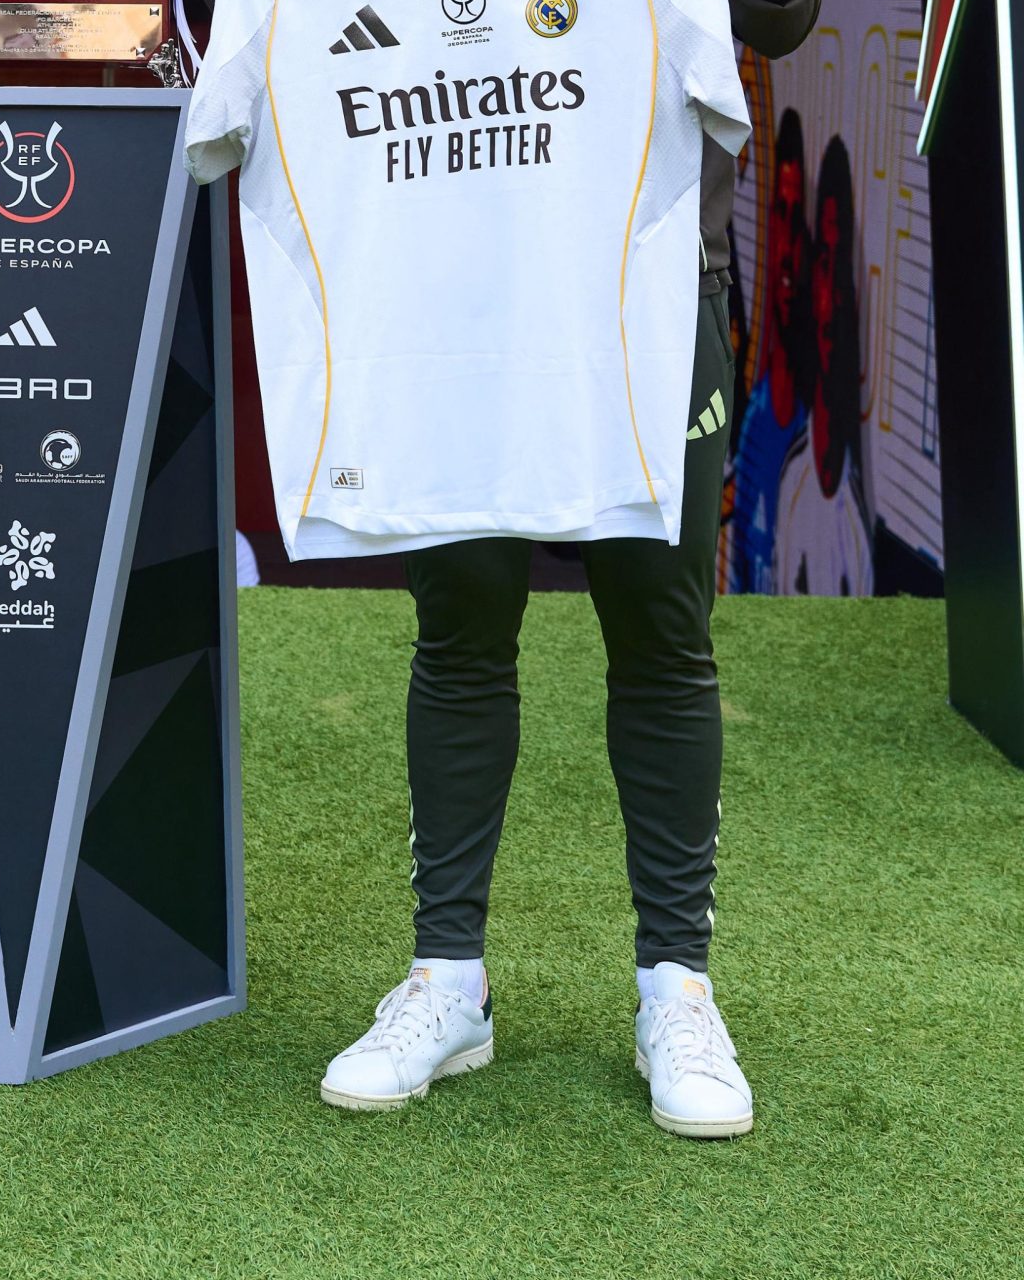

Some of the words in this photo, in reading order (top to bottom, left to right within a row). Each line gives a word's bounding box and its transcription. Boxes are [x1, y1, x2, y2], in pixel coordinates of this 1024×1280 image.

[441, 26, 494, 38] SUPERCOPA
[336, 65, 585, 139] Emirates
[387, 135, 433, 183] FLY
[447, 123, 552, 174] BETTER
[9, 258, 74, 269] ESPAÑA
